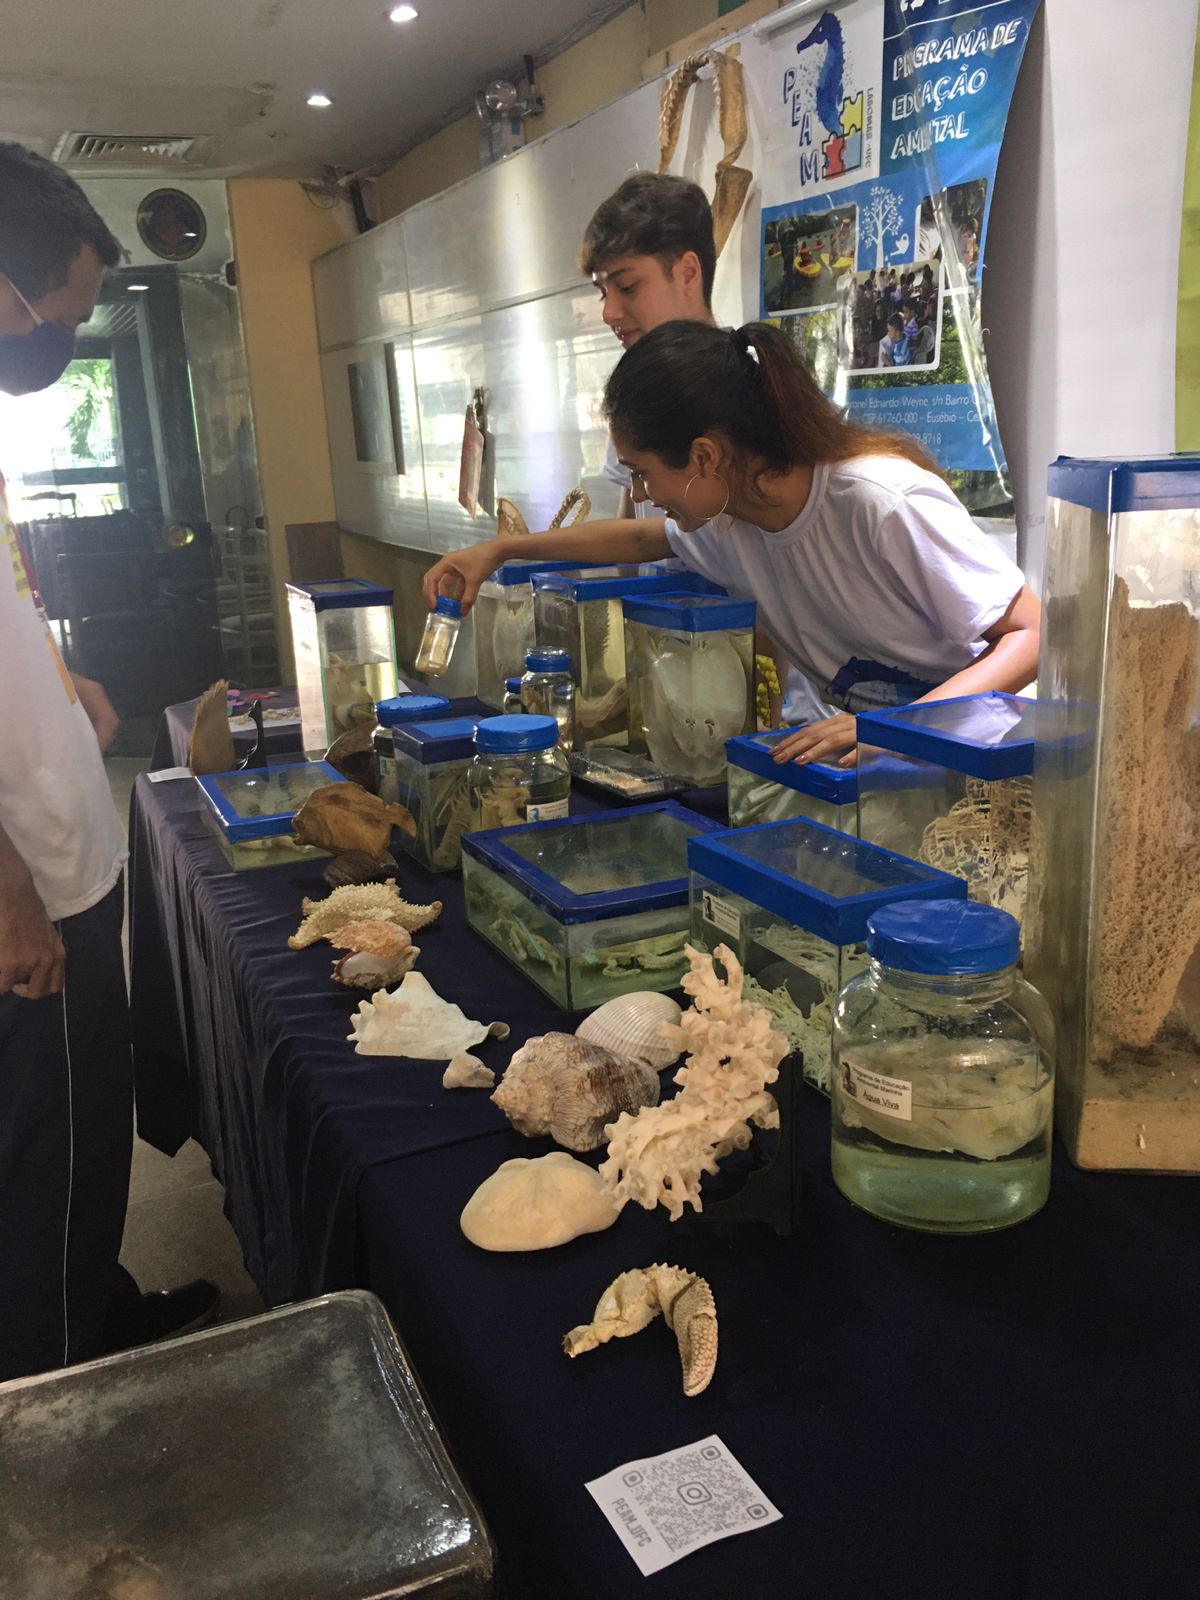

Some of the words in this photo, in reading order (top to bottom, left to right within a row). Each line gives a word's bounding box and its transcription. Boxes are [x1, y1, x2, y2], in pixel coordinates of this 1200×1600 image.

[990, 16, 1024, 50] DE
[945, 394, 969, 406] Bairro
[611, 1497, 652, 1548] PEAM_UFC
